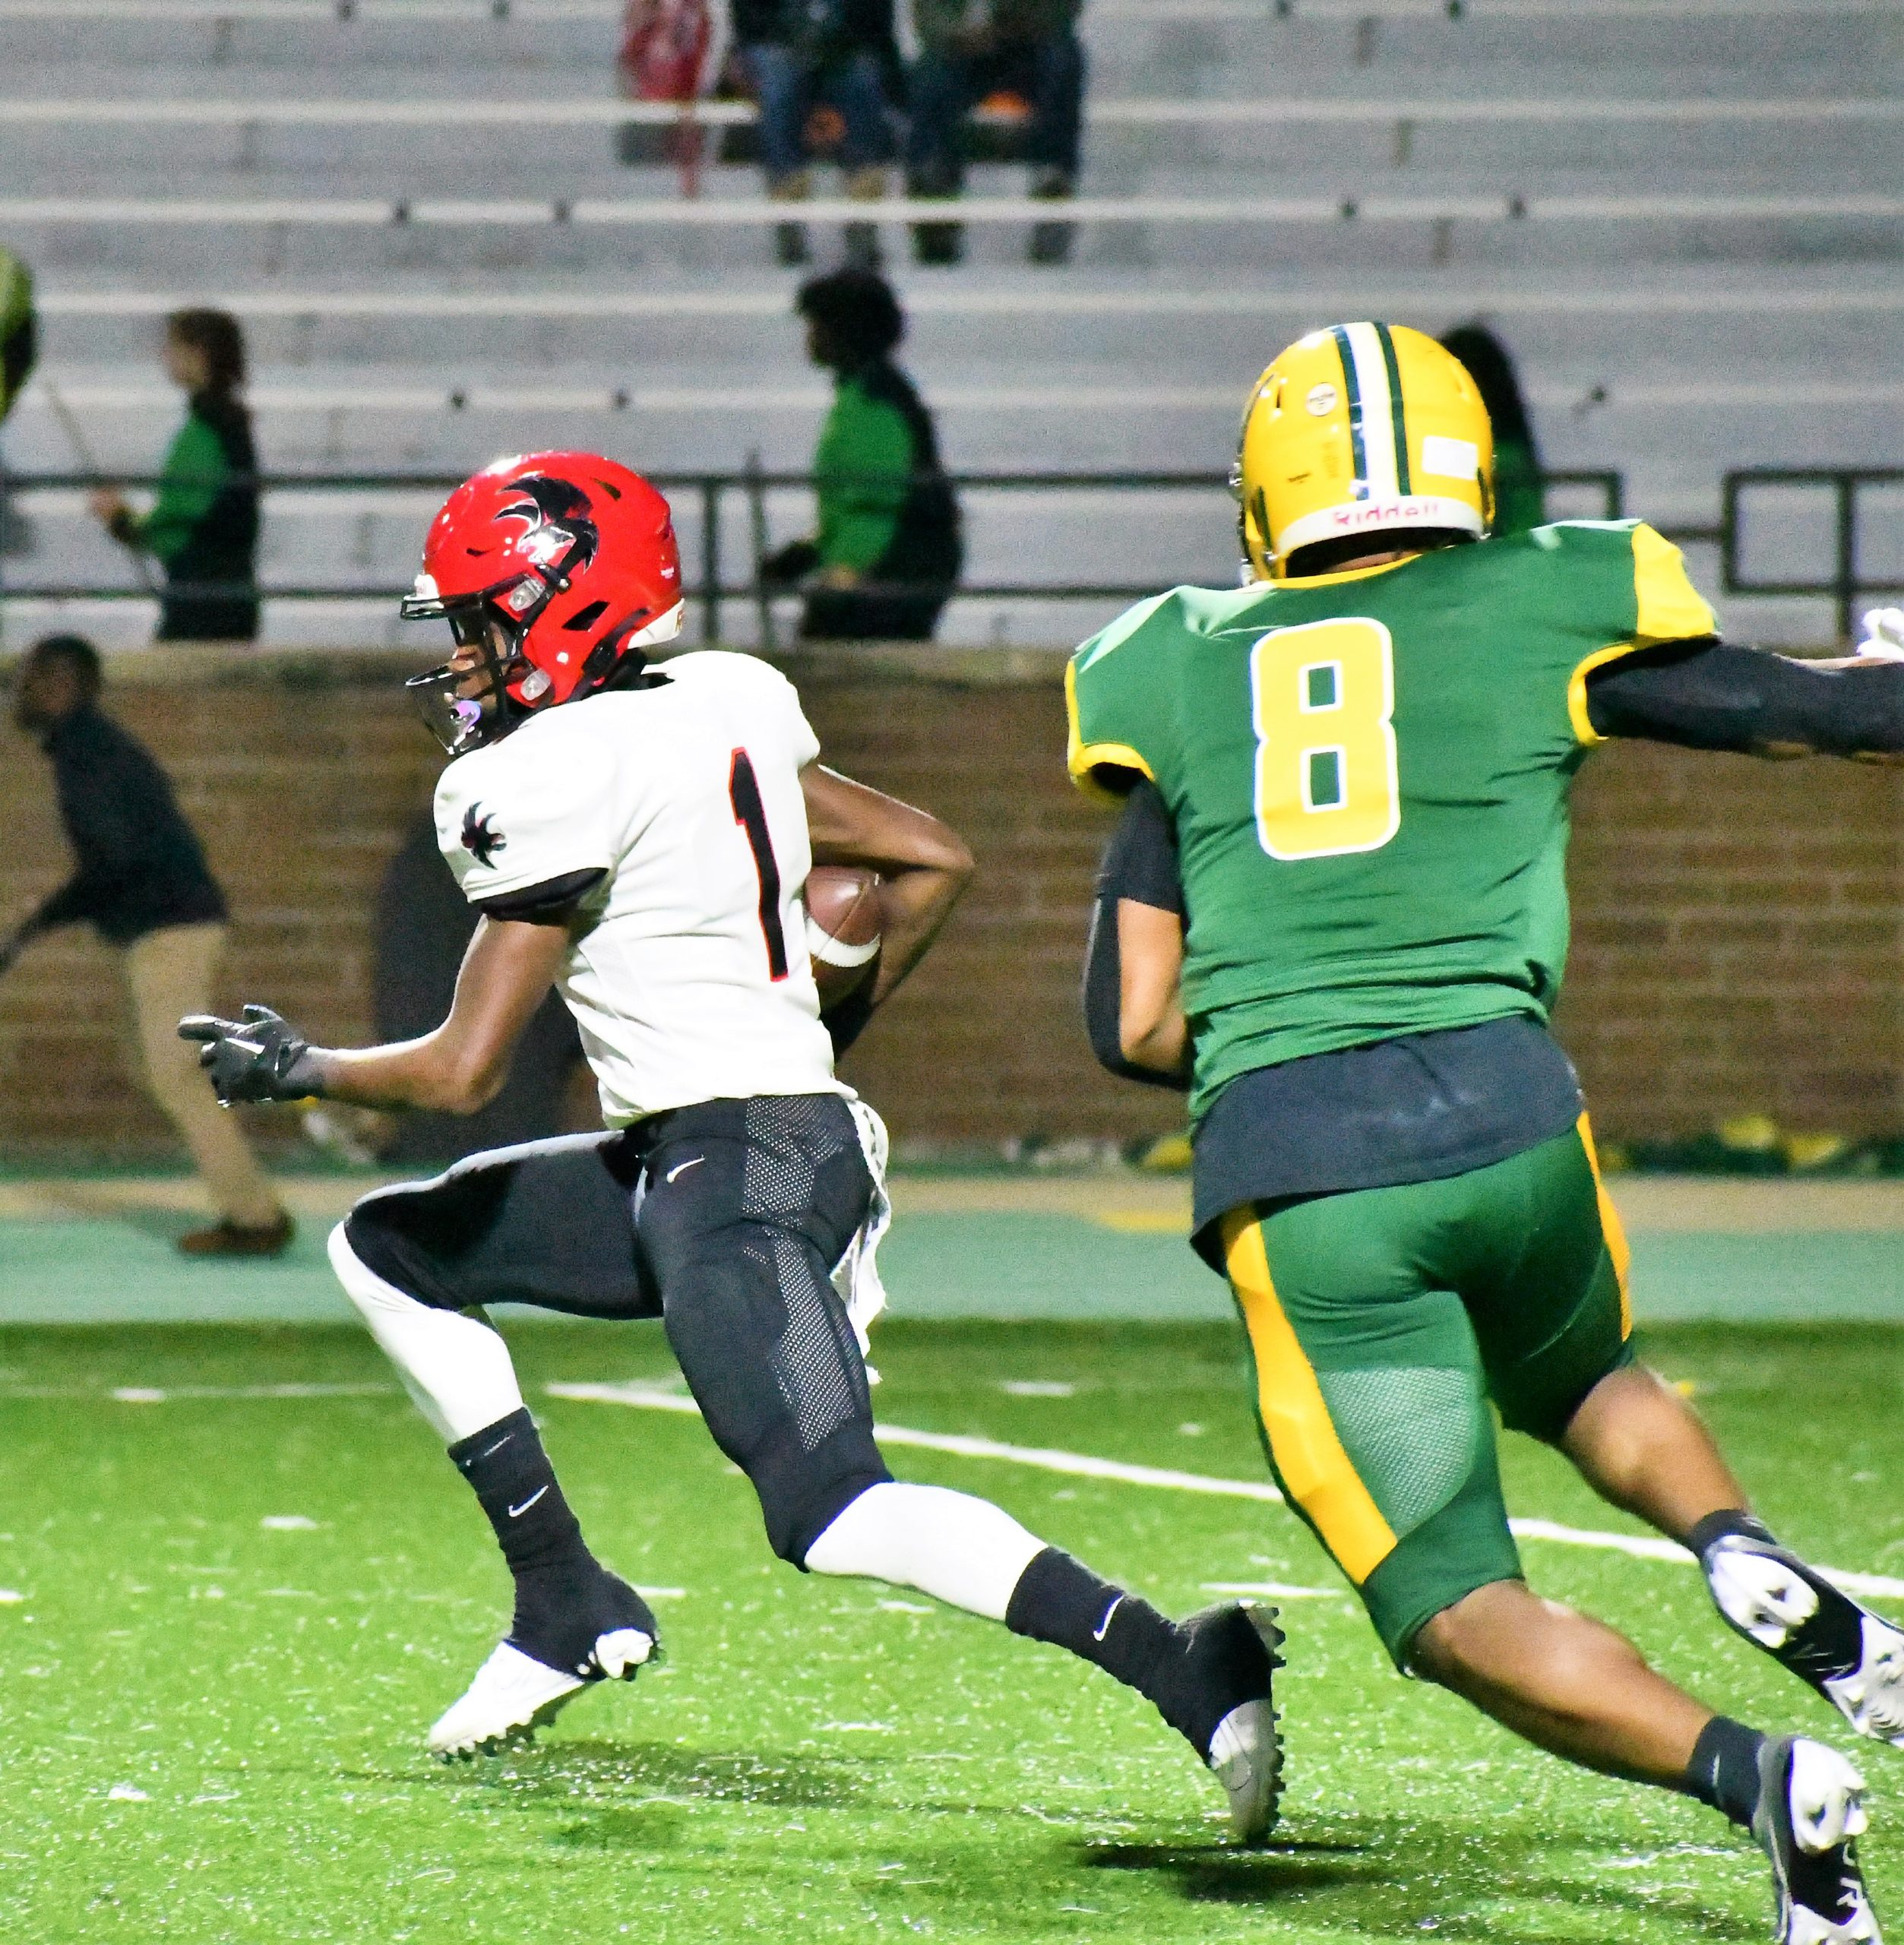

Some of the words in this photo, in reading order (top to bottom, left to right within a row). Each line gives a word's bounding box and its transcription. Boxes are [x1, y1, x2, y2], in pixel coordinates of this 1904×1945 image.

[1333, 503, 1439, 526] Riddell
[1250, 617, 1401, 861] 8
[729, 746, 789, 982] 1
